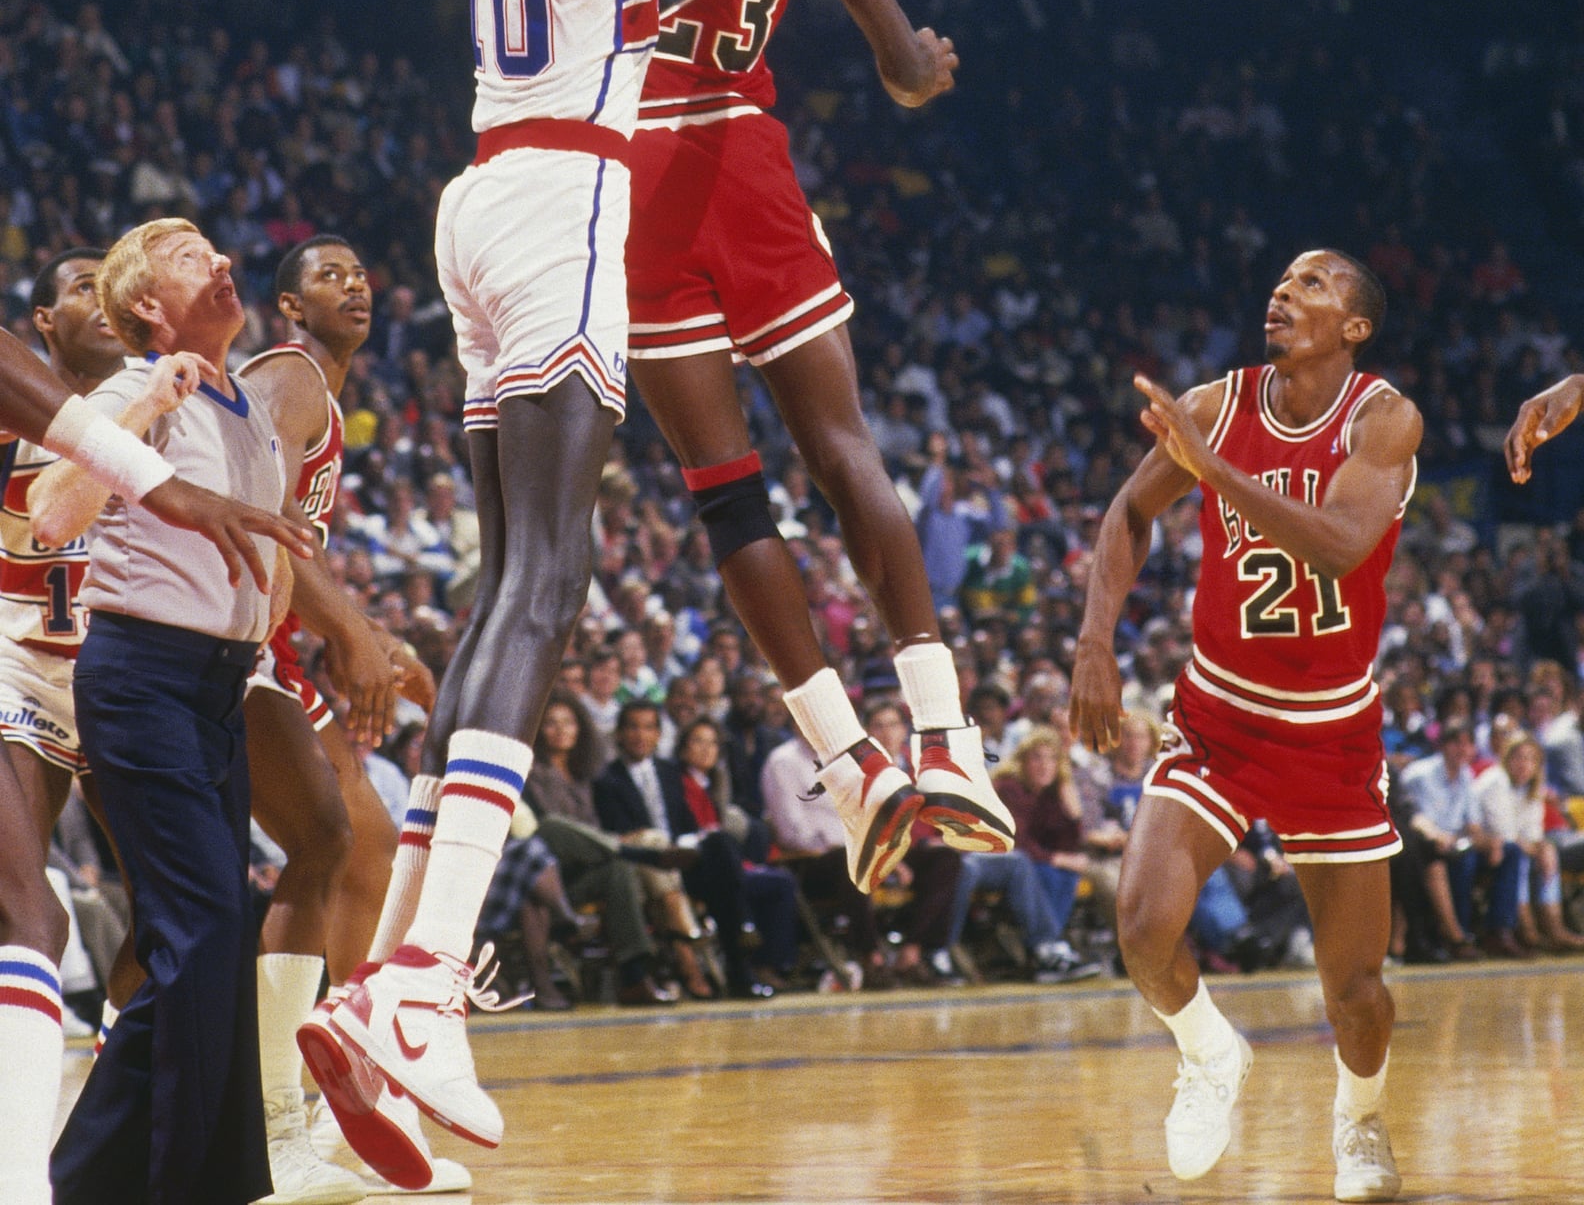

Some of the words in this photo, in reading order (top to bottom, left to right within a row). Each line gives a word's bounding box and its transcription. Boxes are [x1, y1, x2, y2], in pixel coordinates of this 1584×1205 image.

[43, 563, 91, 637] 1
[1237, 547, 1351, 639] 21
[0, 706, 70, 739] ullets
